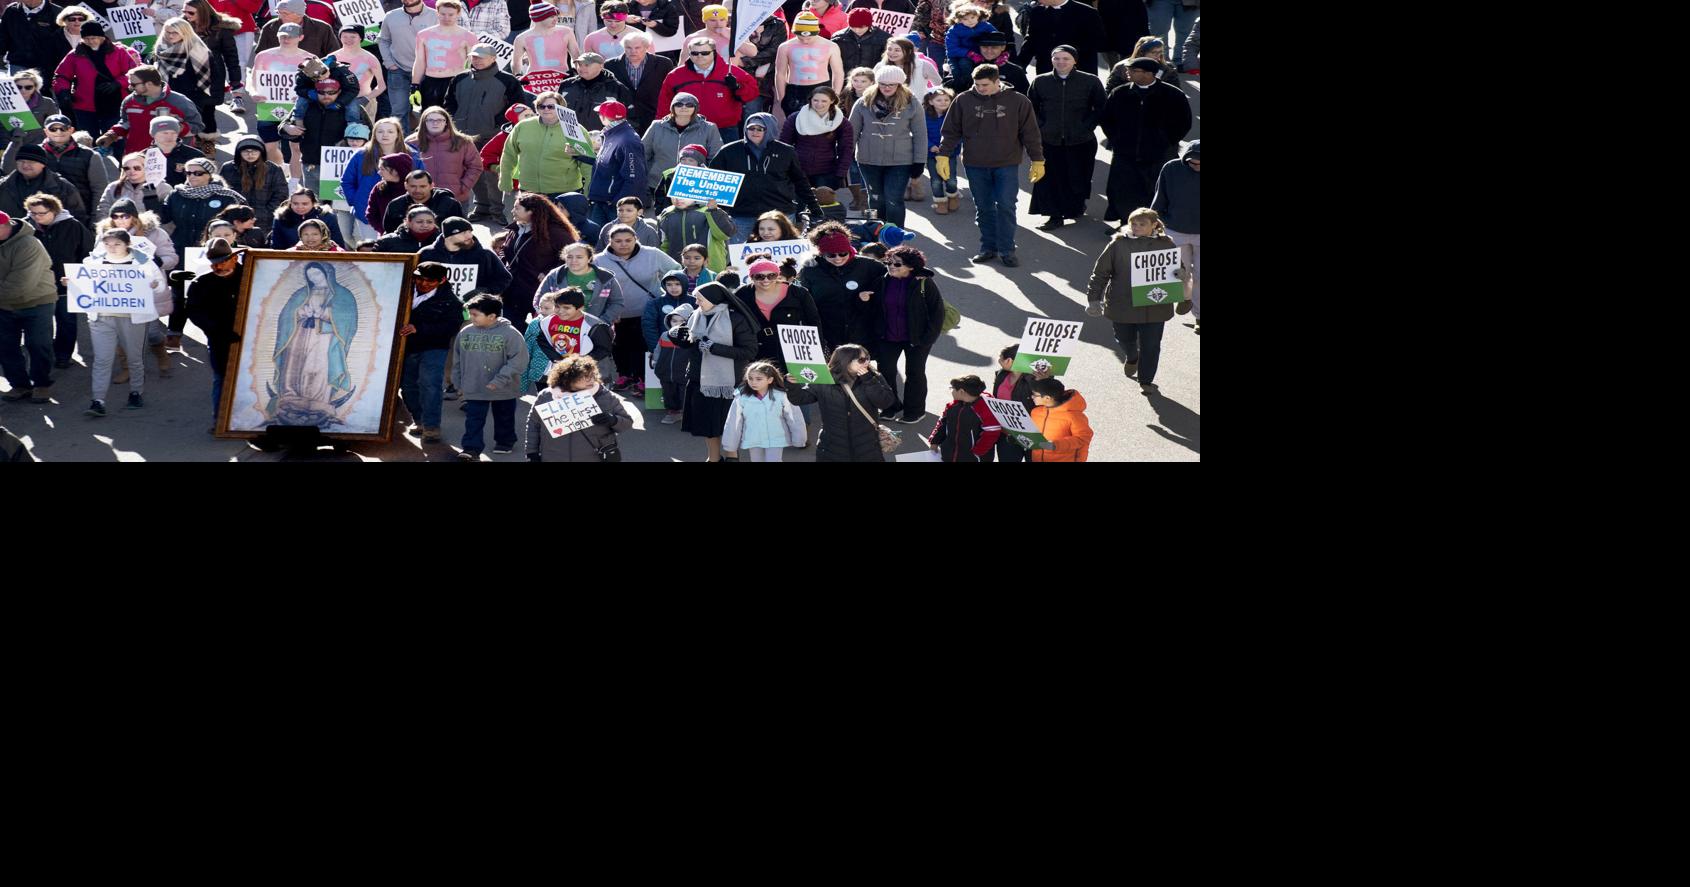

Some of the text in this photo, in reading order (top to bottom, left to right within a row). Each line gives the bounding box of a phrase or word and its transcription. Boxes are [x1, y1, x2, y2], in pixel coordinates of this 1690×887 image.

[123, 21, 143, 35] LIFE
[260, 73, 294, 87] CHOOS
[0, 81, 17, 96] OSE
[270, 87, 290, 101] LIFE
[324, 149, 354, 163] CHO
[335, 163, 344, 178] LI
[678, 167, 740, 184] REMEMBER
[676, 175, 737, 193] The Unborn
[1135, 251, 1178, 269] CHOOSE
[446, 267, 475, 282] OOSE
[1145, 266, 1167, 282] LIFE
[551, 323, 580, 335] MARIO
[781, 328, 818, 345] CHOOSE
[1028, 321, 1079, 339] CHOOSE
[793, 345, 813, 361] LIFE
[1034, 337, 1062, 353] LIFE
[987, 399, 1027, 418] CHOOSE
[543, 415, 569, 428] The
[1002, 414, 1026, 430] LIFE
